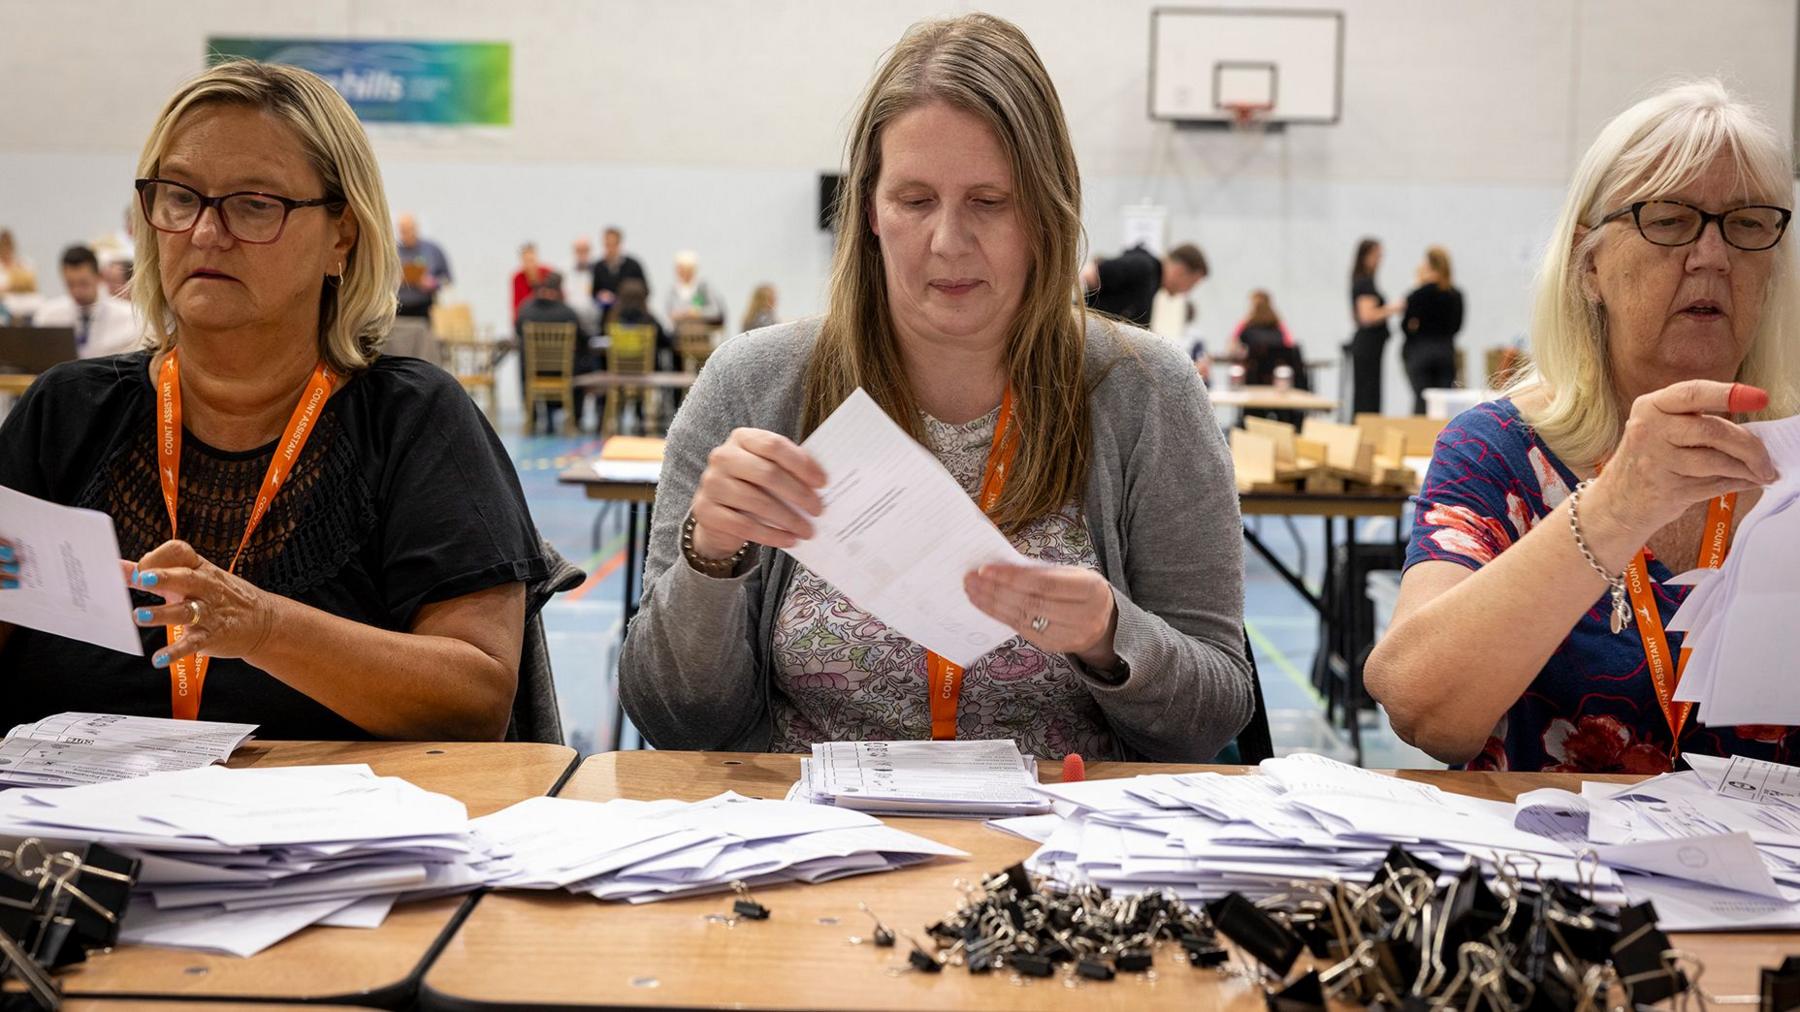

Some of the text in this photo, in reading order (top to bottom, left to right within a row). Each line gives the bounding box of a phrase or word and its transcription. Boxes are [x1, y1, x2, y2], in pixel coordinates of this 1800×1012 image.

[163, 381, 174, 456] COUNT ASSISTANT
[285, 387, 324, 461] COUNT ASSISTANT
[1713, 521, 1725, 553] COUNT
[1628, 562, 1641, 594] COUNT
[1646, 636, 1667, 689] ASSISTANT
[177, 663, 188, 697] COUNT
[942, 665, 955, 699] COUNT
